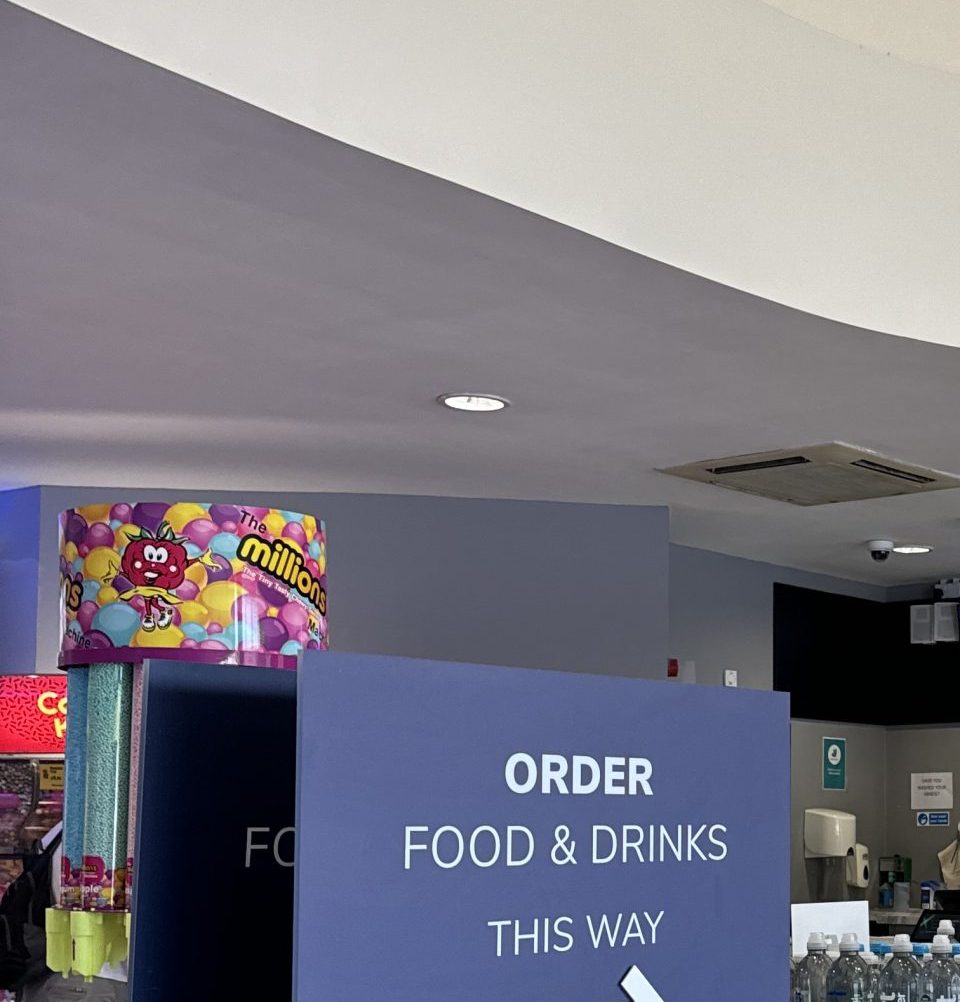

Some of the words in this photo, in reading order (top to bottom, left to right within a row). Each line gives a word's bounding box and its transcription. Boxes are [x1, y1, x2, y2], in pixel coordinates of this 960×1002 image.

[240, 510, 267, 534] The
[238, 534, 327, 615] millions
[243, 566, 256, 578] The
[259, 575, 273, 588] Tiny
[505, 752, 654, 796] ORDER
[245, 827, 296, 868] FO
[404, 825, 535, 869] FOOD
[551, 825, 578, 865] &
[593, 823, 728, 863] DRINKS
[488, 917, 574, 957] THIS
[587, 910, 665, 949] WAY
